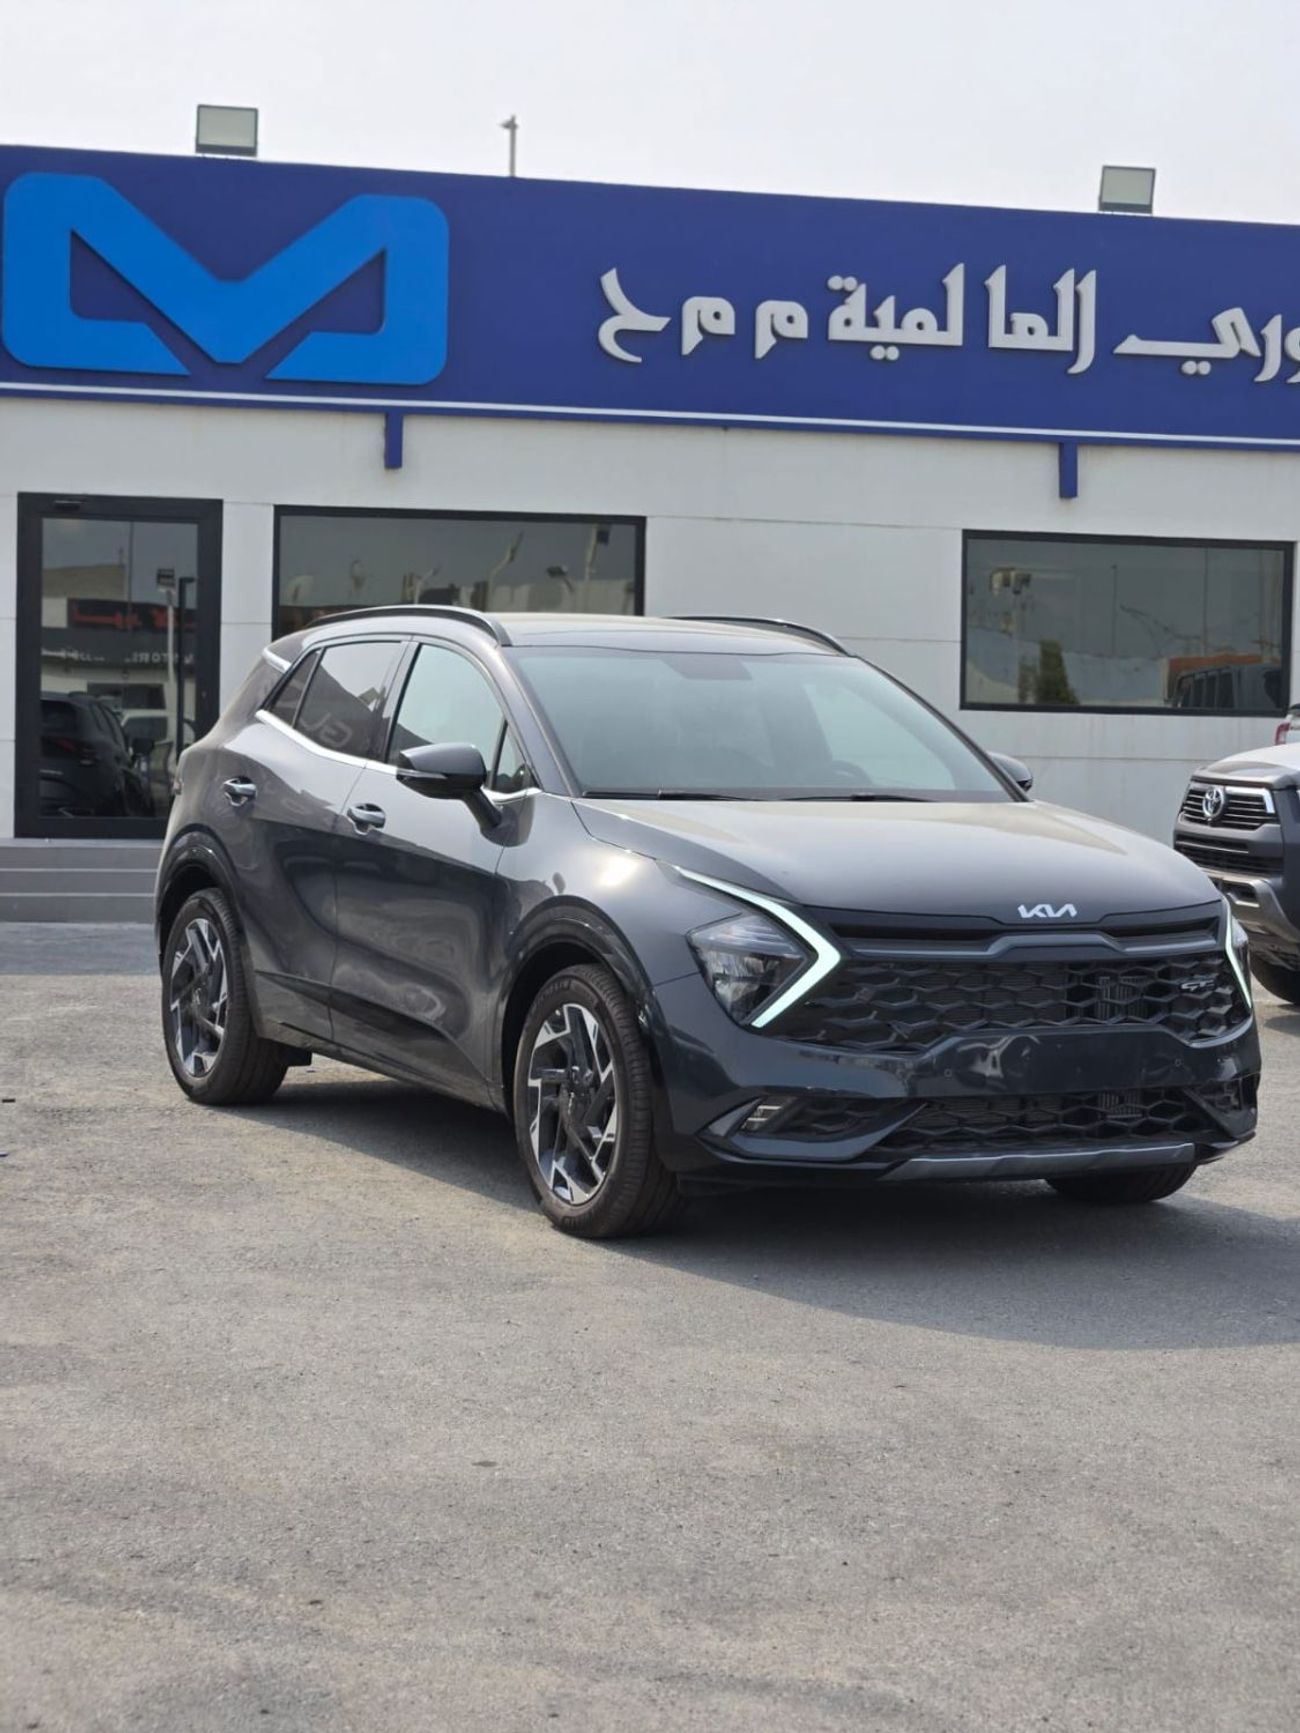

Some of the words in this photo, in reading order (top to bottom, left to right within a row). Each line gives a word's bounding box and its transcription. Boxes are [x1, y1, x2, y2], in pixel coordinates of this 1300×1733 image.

[598, 266, 672, 364] ح
[681, 295, 736, 356] م
[755, 299, 809, 360] م
[827, 262, 1097, 375] العالمية
[1017, 903, 1077, 918] KIA
